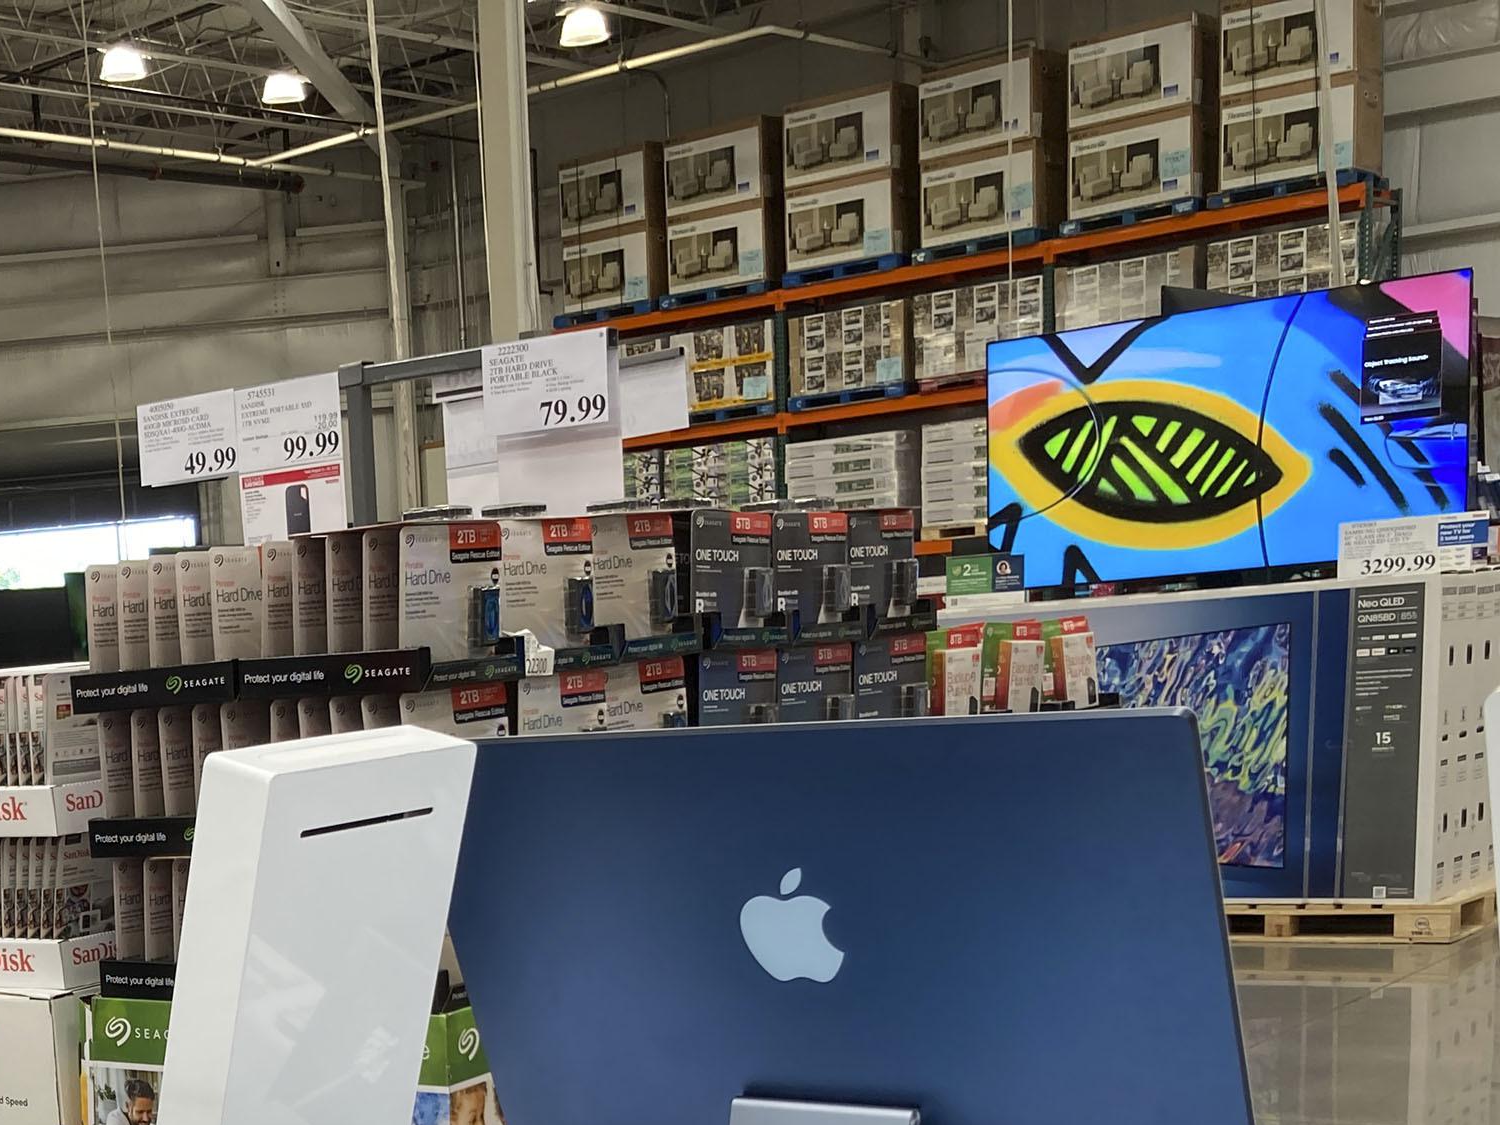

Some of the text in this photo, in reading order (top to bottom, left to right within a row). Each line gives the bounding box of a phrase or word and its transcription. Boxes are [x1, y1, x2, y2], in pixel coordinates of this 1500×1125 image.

[489, 355, 525, 368] SEAGATE
[489, 359, 554, 377] 2TB HARD DRIVE
[489, 367, 559, 385] PORTABLE BLACK
[540, 394, 606, 427] 79.99
[283, 430, 340, 461] 99.99
[184, 446, 237, 475] 49.99
[549, 524, 569, 538] 2TB
[634, 520, 651, 533] 2TB
[457, 529, 476, 544] 2TB
[503, 561, 548, 577] Hard Drive
[1361, 554, 1436, 575] 3299.99
[405, 569, 451, 586] Hard Drive
[216, 587, 262, 603] Hard Drive
[1357, 597, 1405, 609] Neo QLED
[244, 667, 411, 685] Protect your digital life SEAGATE
[76, 676, 226, 699] Protect your digital life SEAGATE
[1375, 732, 1391, 744] 15
[66, 790, 103, 812] SanD
[95, 832, 167, 845] Protect your digital life
[72, 941, 117, 966] SanDis
[106, 974, 129, 985] Protect
[130, 977, 143, 986] your
[145, 977, 164, 987] digital
[5, 1096, 29, 1107] Speed
